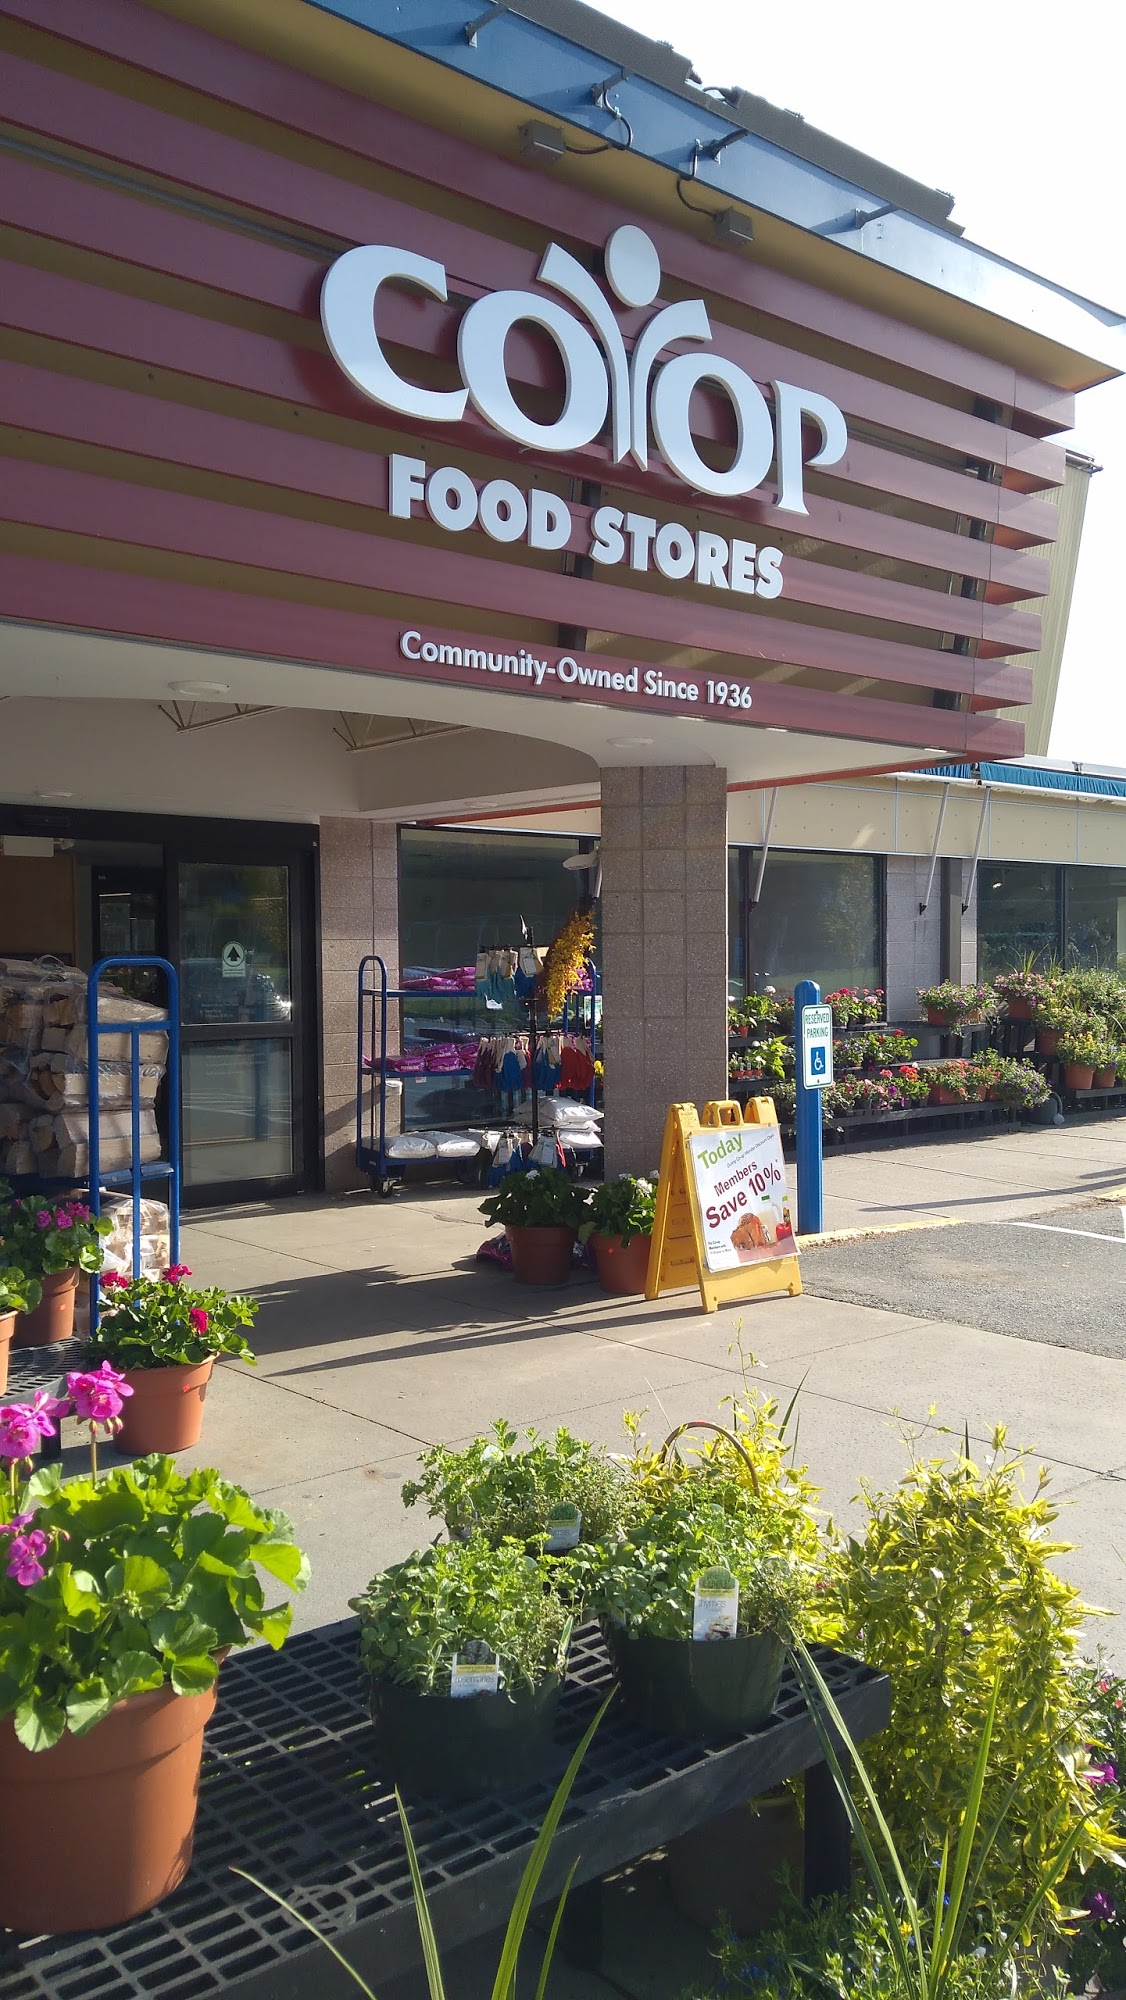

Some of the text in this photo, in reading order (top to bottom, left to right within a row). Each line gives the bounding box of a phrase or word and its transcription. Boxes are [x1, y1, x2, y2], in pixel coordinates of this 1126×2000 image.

[388, 453, 784, 600] FOOD STORES
[400, 630, 752, 709] Community-Owned Since 1936
[804, 1013, 829, 1024] RESERVED
[806, 1026, 829, 1039] PARKING
[697, 1132, 743, 1170] Today
[713, 1161, 758, 1197] Members
[706, 1191, 748, 1229] Save
